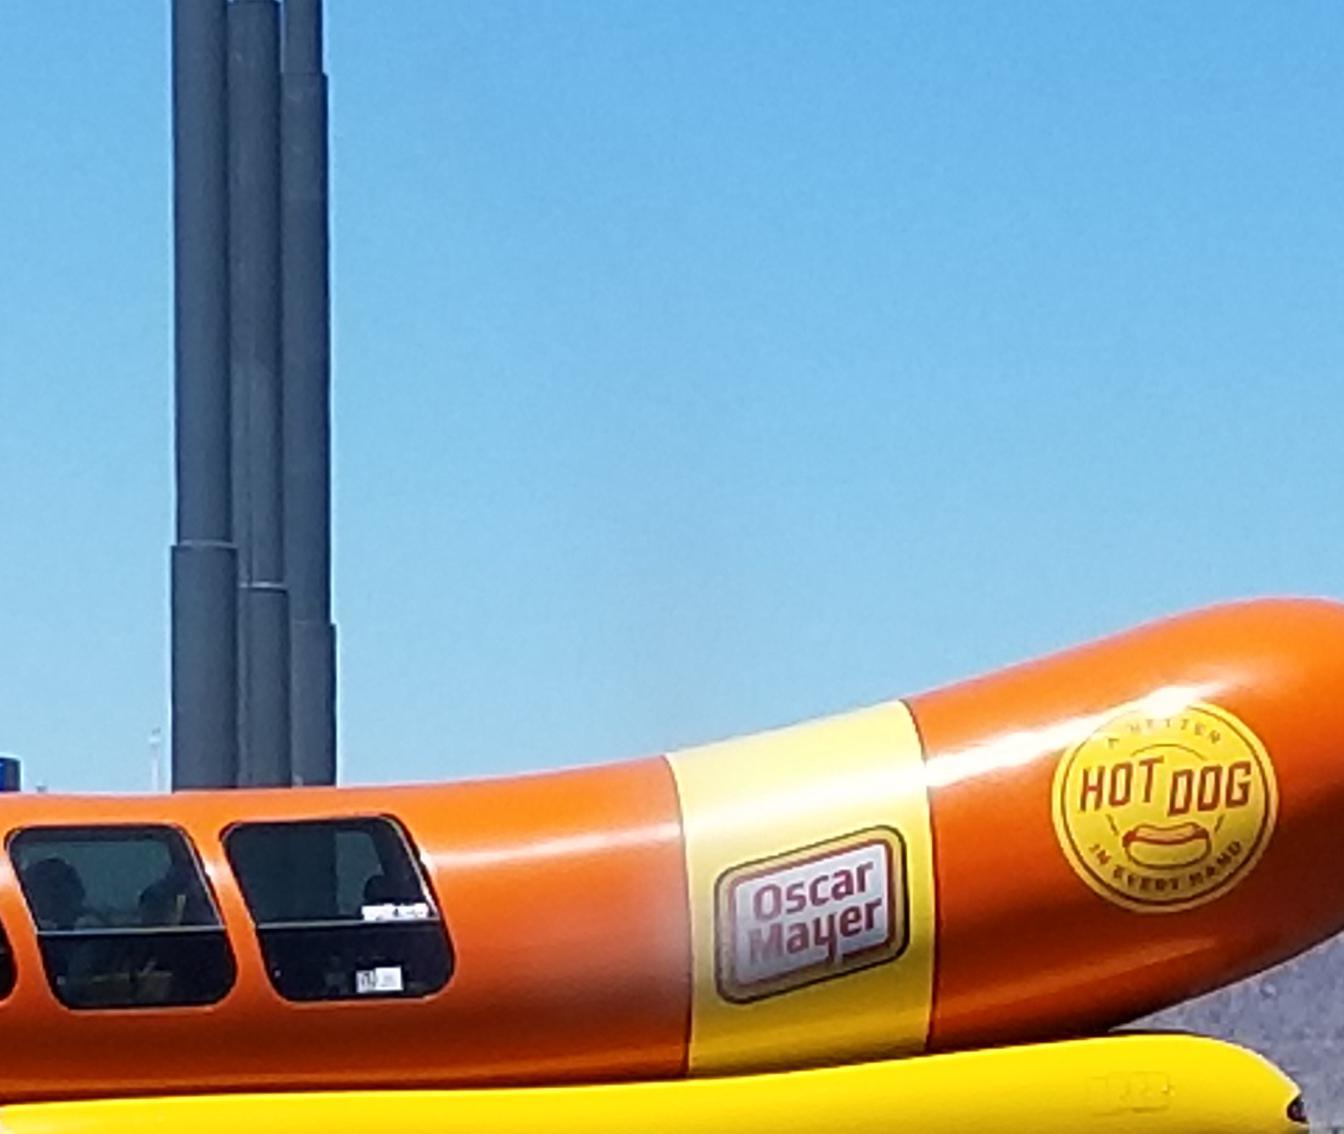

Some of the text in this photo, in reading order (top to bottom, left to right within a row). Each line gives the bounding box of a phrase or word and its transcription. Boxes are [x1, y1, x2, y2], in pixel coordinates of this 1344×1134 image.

[1079, 755, 1252, 818] HOT DOG
[751, 860, 874, 924] Oscar
[746, 898, 883, 966] Mayer
